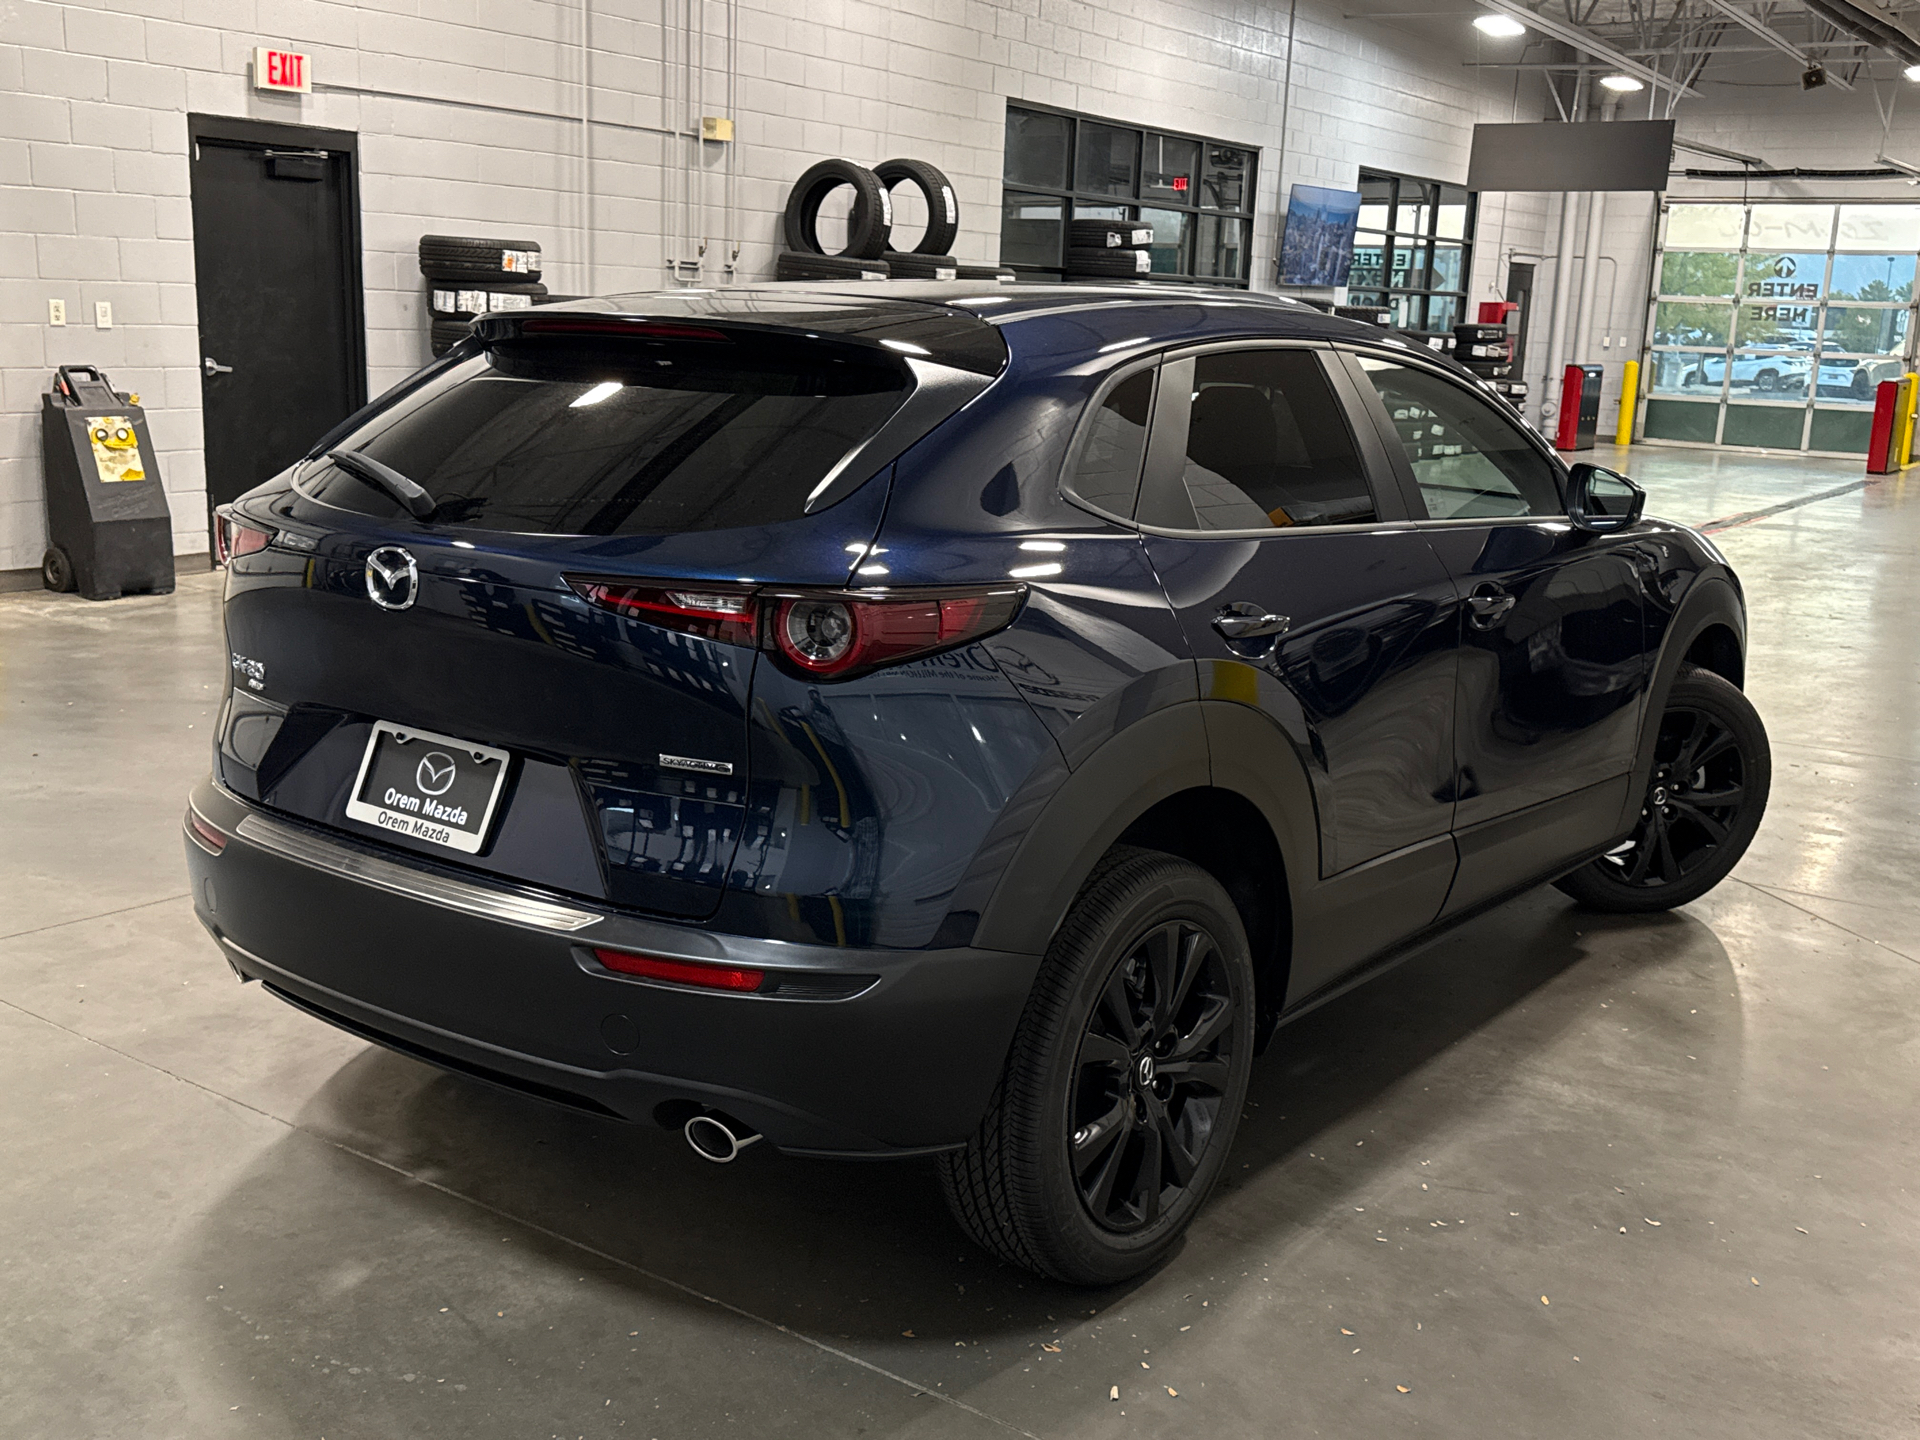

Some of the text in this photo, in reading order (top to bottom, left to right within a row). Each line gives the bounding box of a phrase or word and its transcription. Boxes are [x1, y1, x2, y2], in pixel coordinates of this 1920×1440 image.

[267, 51, 304, 88] EXIT
[384, 787, 468, 826] Orem Mazda
[377, 810, 450, 844] Orem Mazda
